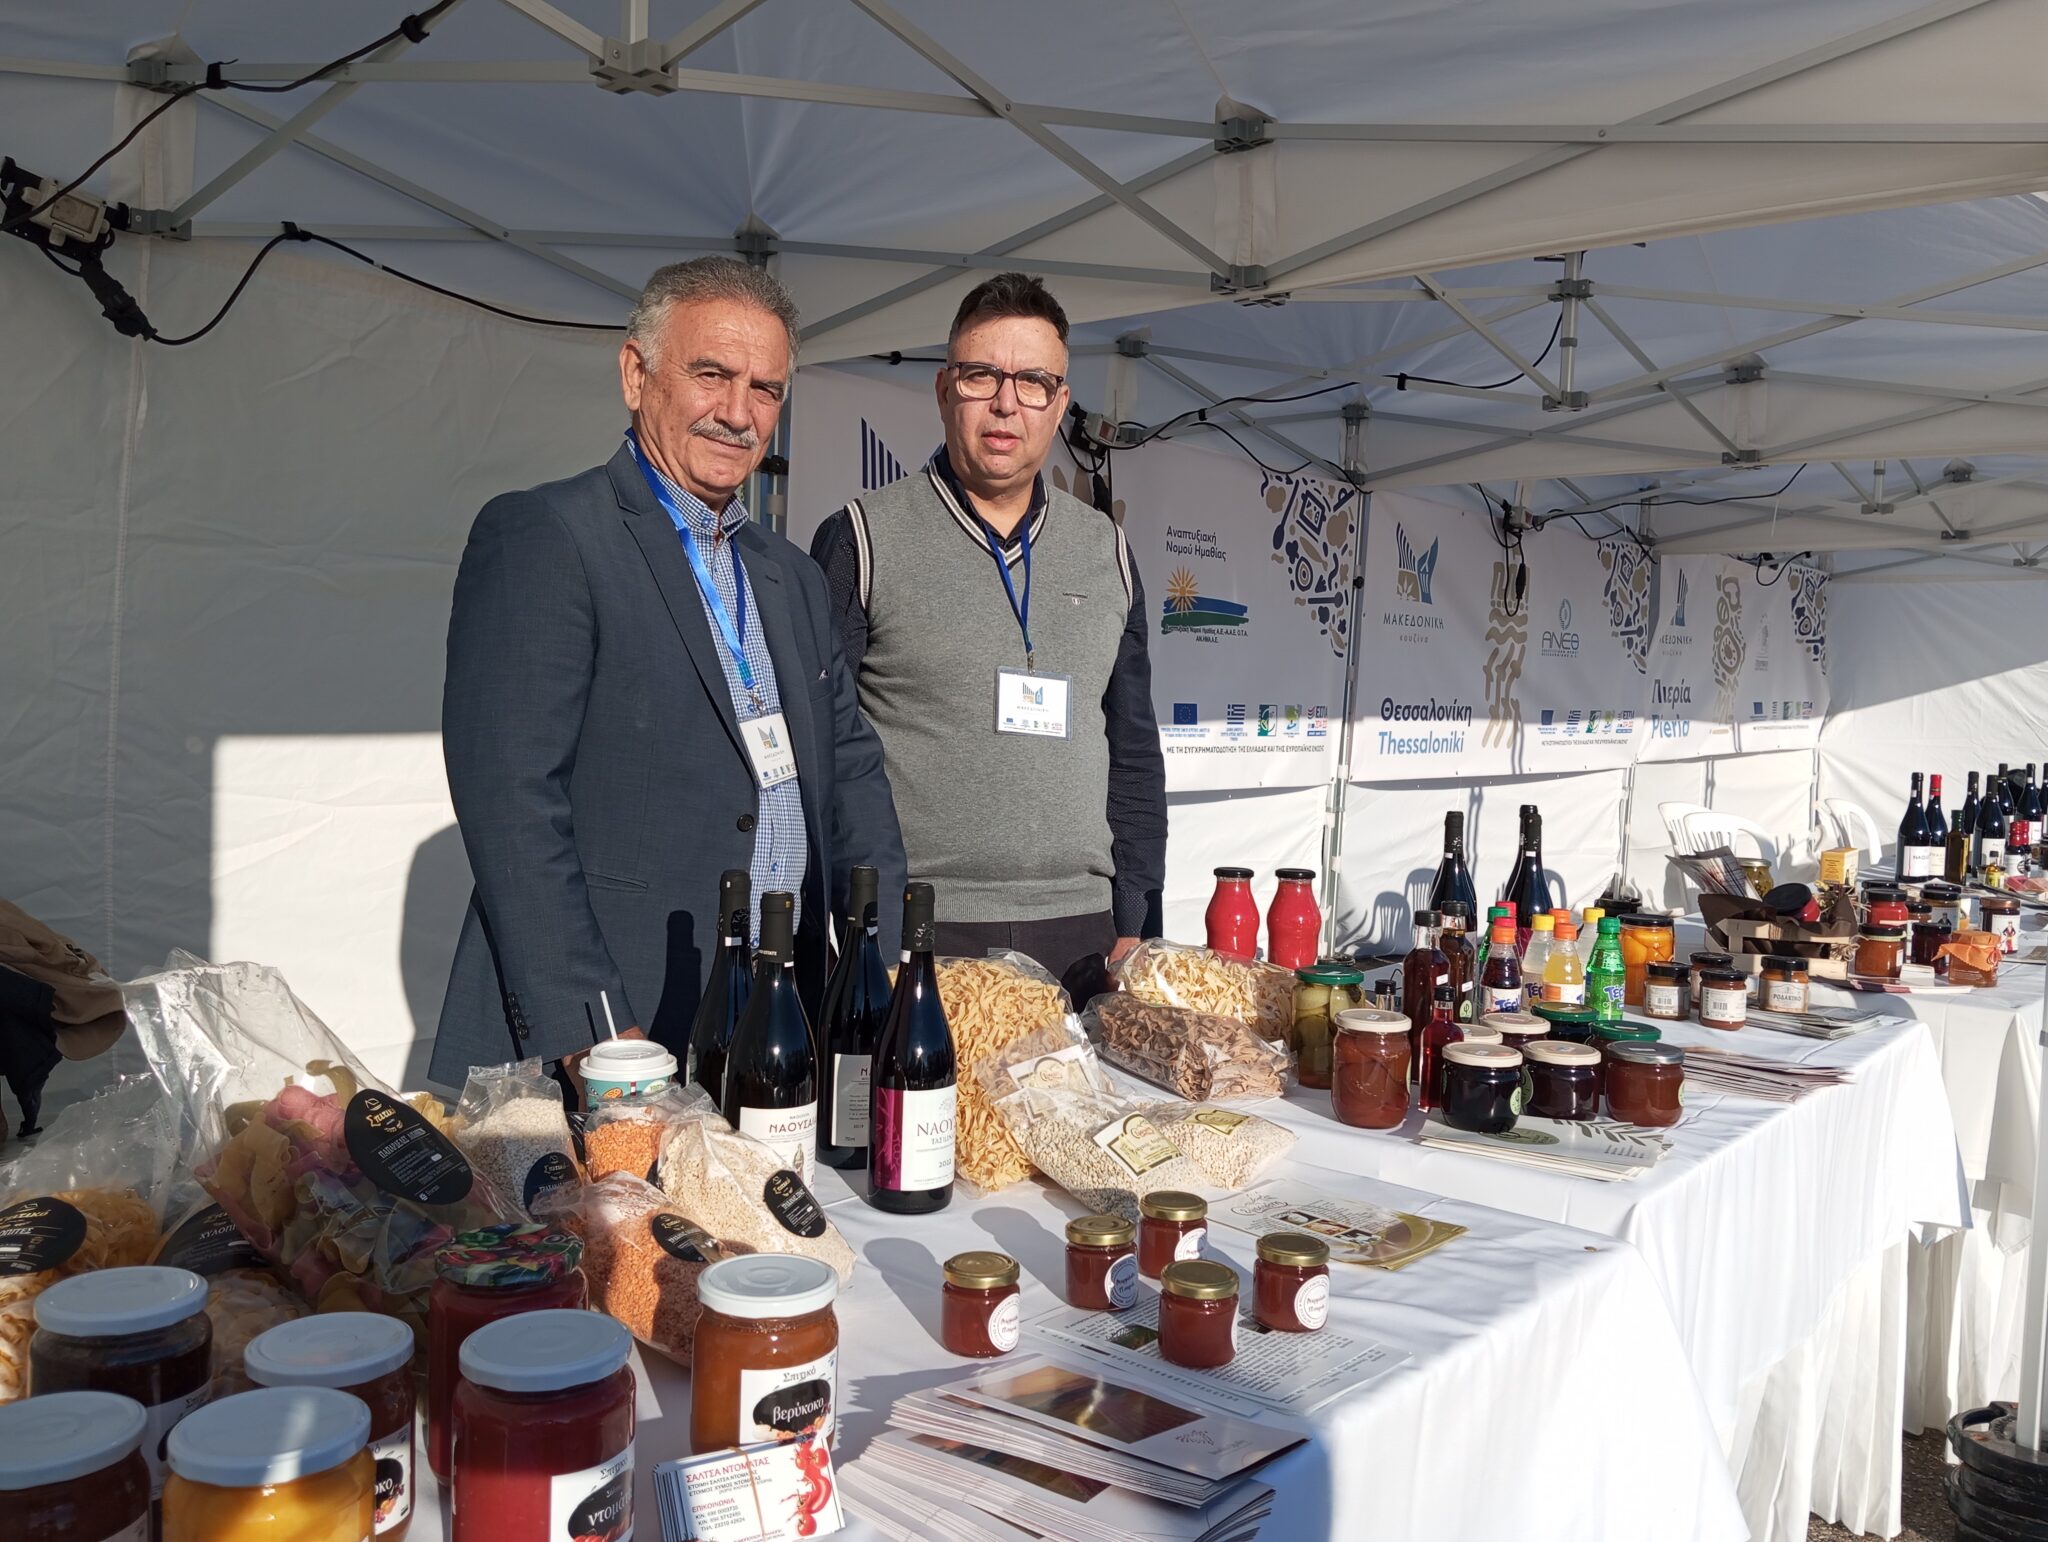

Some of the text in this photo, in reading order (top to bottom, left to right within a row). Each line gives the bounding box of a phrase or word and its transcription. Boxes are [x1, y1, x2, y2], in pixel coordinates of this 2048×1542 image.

[1166, 525, 1217, 546] Αναπτυξιακή
[1166, 541, 1227, 562] Νομού Ημαθίας
[1383, 612, 1445, 630] ΜΑΚΕΔΟΝΙΚΗ
[1652, 678, 1692, 710] Πιερία
[1381, 697, 1472, 727] Θεσσαλονίκη
[1378, 731, 1465, 755] Thessaloniki
[199, 1223, 237, 1240] ΧΥΛΟΠΙ
[773, 1397, 824, 1425] βερύκοκο
[686, 1468, 722, 1483] ΣΑΛΤΣΑ
